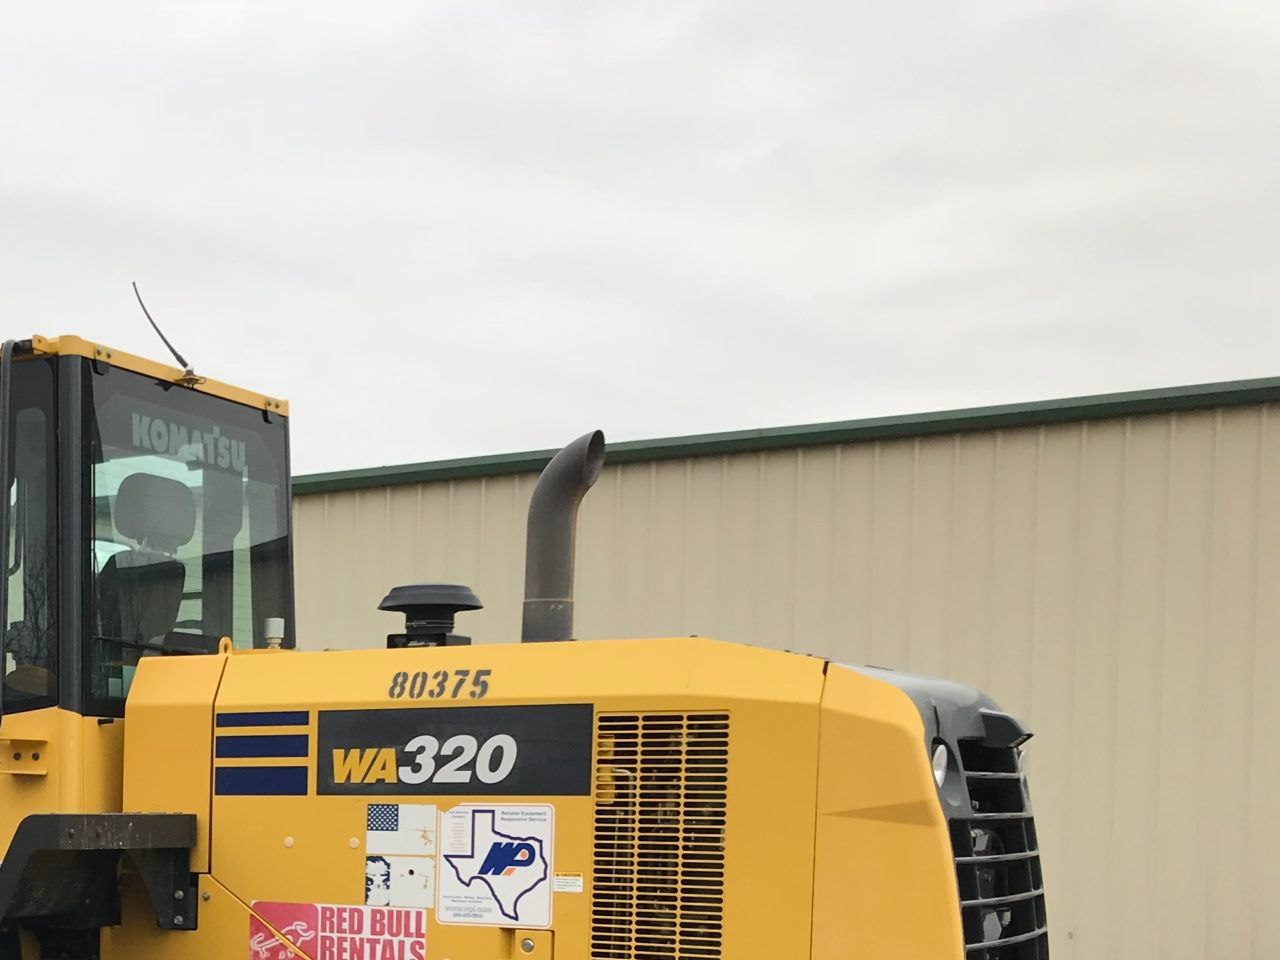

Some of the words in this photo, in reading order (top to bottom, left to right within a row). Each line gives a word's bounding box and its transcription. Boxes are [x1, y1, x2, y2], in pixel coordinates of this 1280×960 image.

[132, 413, 246, 472] KOMATSU
[388, 669, 492, 699] 80375
[332, 734, 518, 784] WA320
[320, 906, 364, 935] RED
[370, 908, 426, 938] BULL
